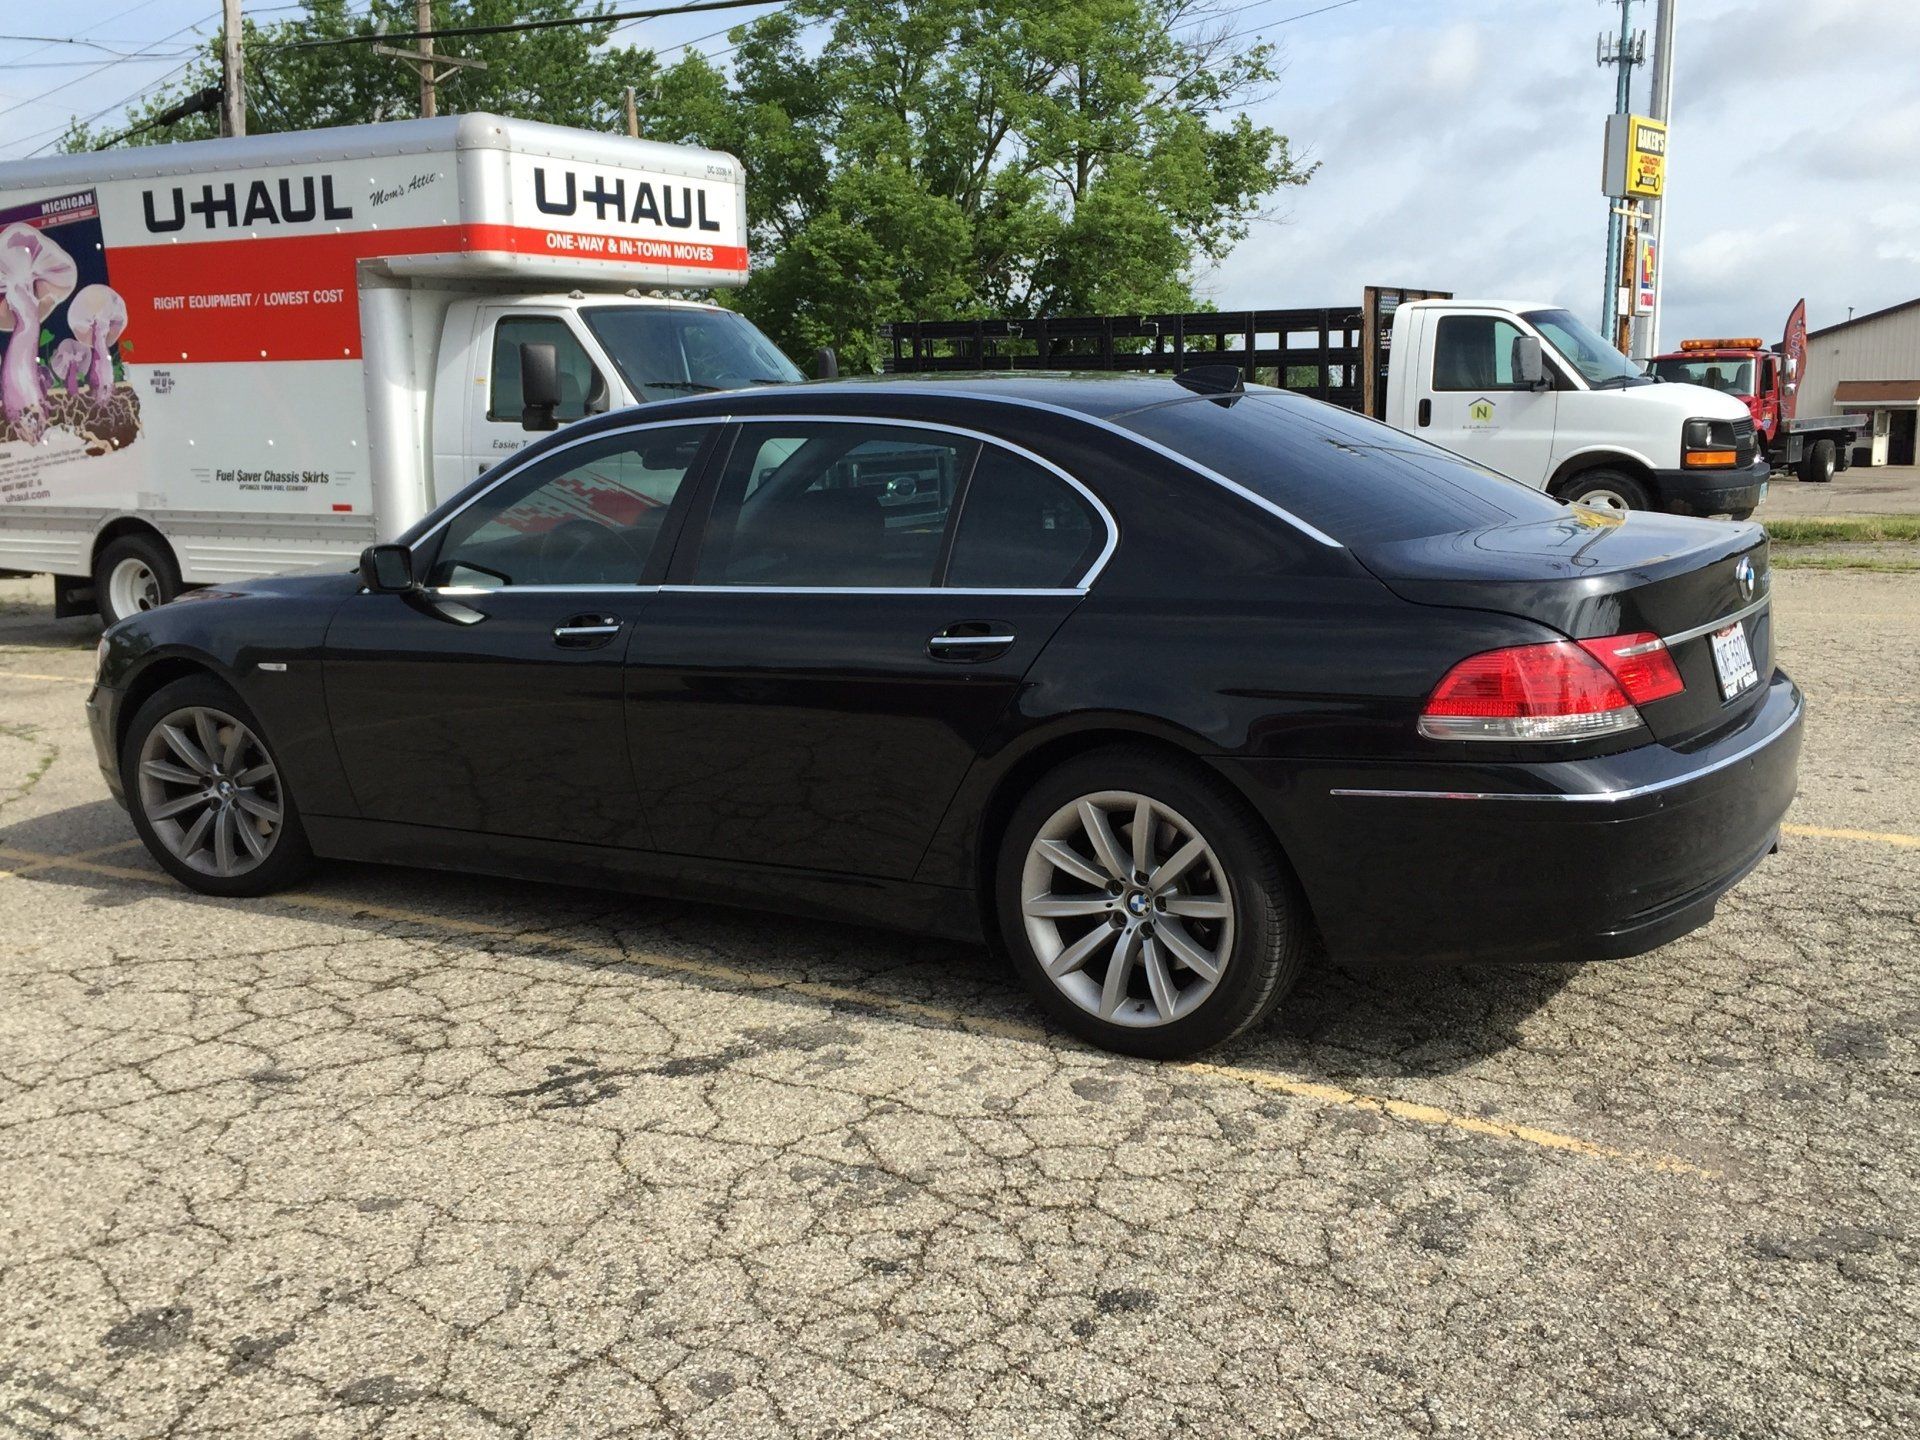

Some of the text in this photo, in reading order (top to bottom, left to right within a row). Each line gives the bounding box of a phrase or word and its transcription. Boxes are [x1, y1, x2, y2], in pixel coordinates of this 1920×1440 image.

[1638, 128, 1665, 153] BAKER'S
[369, 172, 436, 207] Mom's Attic
[533, 167, 720, 232] U-HAUL
[41, 193, 93, 215] MICHIGAN
[142, 175, 353, 233] U-HAUL
[546, 232, 714, 262] ONE-WAY & IN-TOWN MOVES
[153, 296, 185, 310] RIGHT
[189, 293, 252, 310] EQUIPMENT
[263, 291, 309, 306] LOWEST
[313, 289, 344, 304] COST
[1476, 406, 1488, 418] N
[492, 439, 519, 449] Easier
[216, 469, 235, 482] Fuel
[264, 470, 300, 483] Chassis
[302, 470, 329, 484] Skirts
[5, 489, 51, 503] uhaul.com
